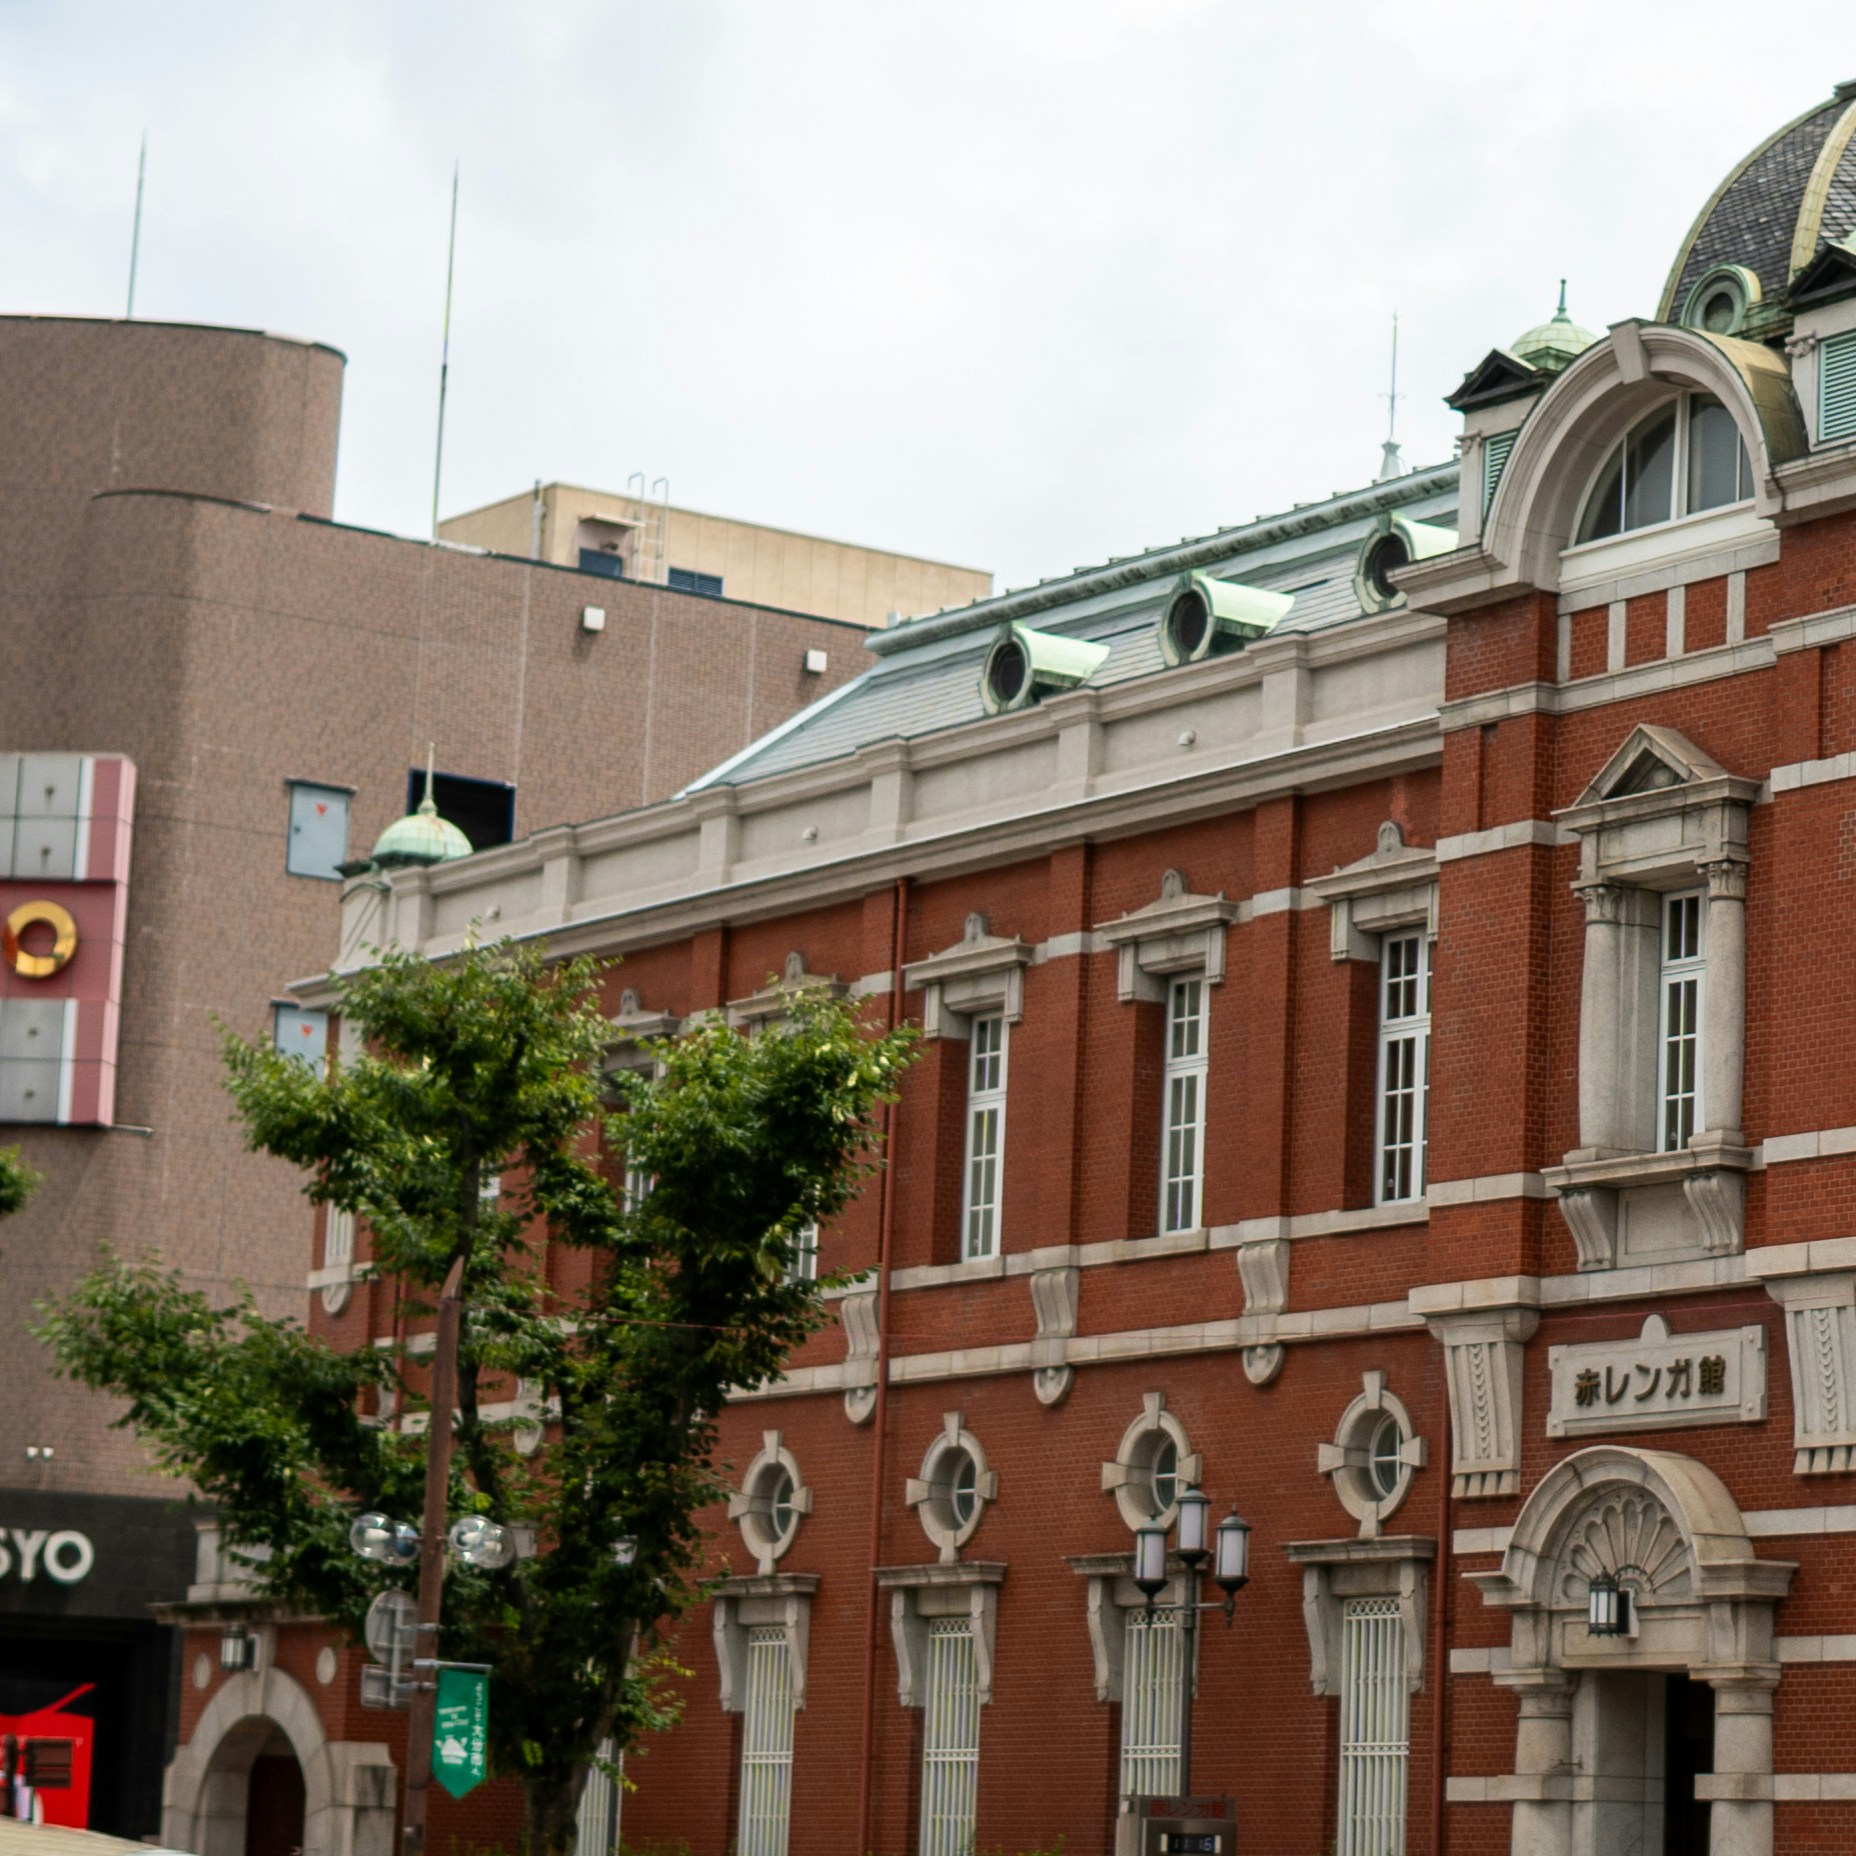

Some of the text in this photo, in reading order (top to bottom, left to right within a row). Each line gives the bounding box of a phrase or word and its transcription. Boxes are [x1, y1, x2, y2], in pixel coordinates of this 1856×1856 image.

[1575, 1355, 1726, 1407] 赤レンガ館
[1151, 1800, 1226, 1819] 赤レンガ館
